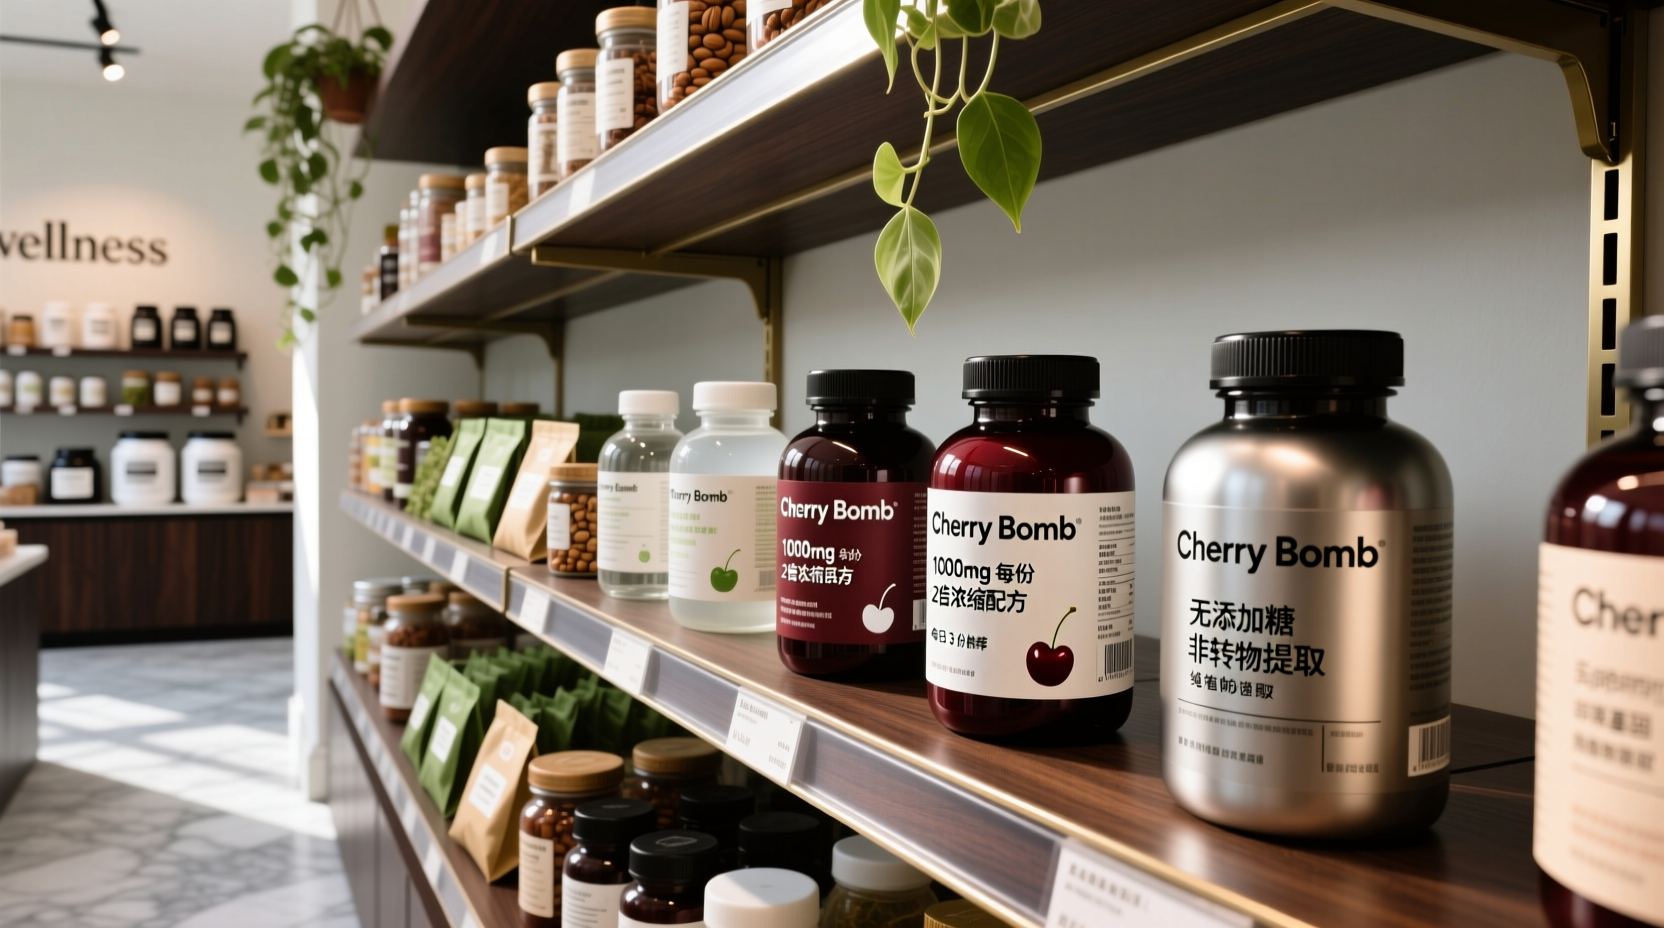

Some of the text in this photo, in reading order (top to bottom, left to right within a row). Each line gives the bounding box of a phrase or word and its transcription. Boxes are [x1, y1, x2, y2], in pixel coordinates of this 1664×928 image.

[780, 496, 829, 525] Cherry
[932, 511, 993, 545] Cherry
[782, 538, 835, 565] 1000mg
[1177, 529, 1267, 574] Cherry
[933, 556, 1035, 585] 1000mg 每份
[1189, 598, 1295, 637] 无添加糖
[1188, 632, 1326, 677] 非转物提取
